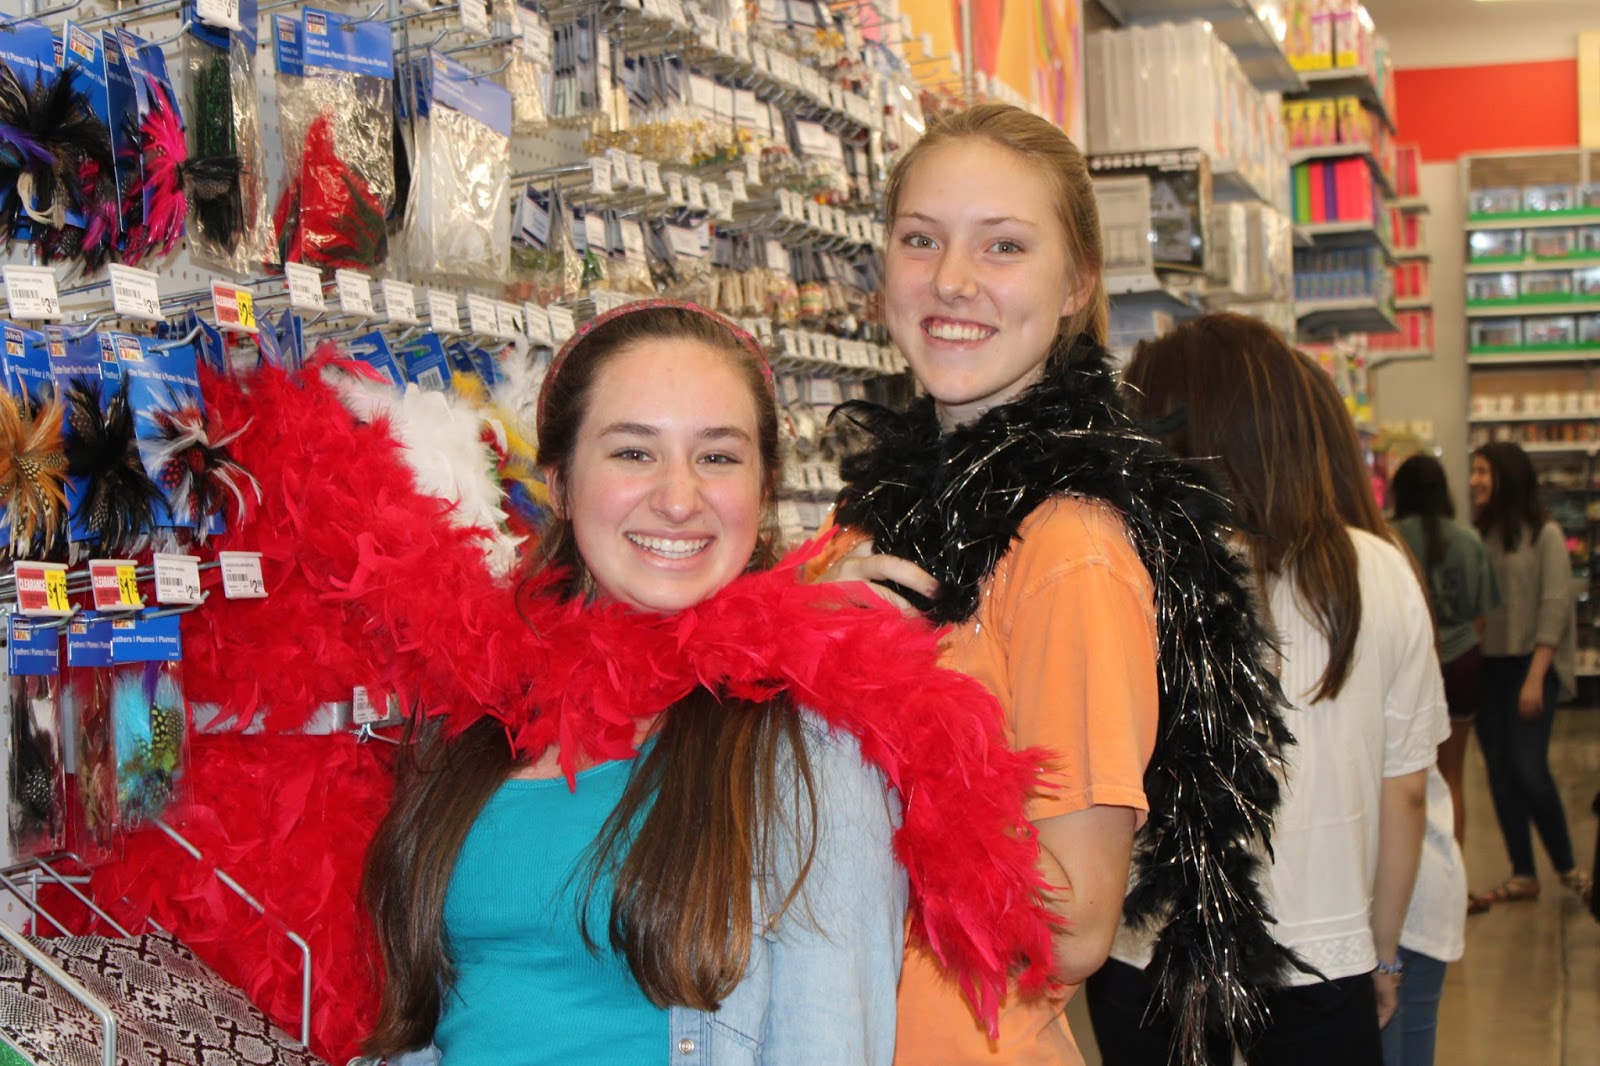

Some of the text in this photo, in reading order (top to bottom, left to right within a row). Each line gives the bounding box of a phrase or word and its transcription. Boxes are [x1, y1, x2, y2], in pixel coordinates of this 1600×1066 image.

[18, 577, 47, 592] CLEARANCE
[92, 575, 119, 588] CLEARANCE
[136, 635, 157, 644] Plumes
[158, 635, 177, 644] Plumas
